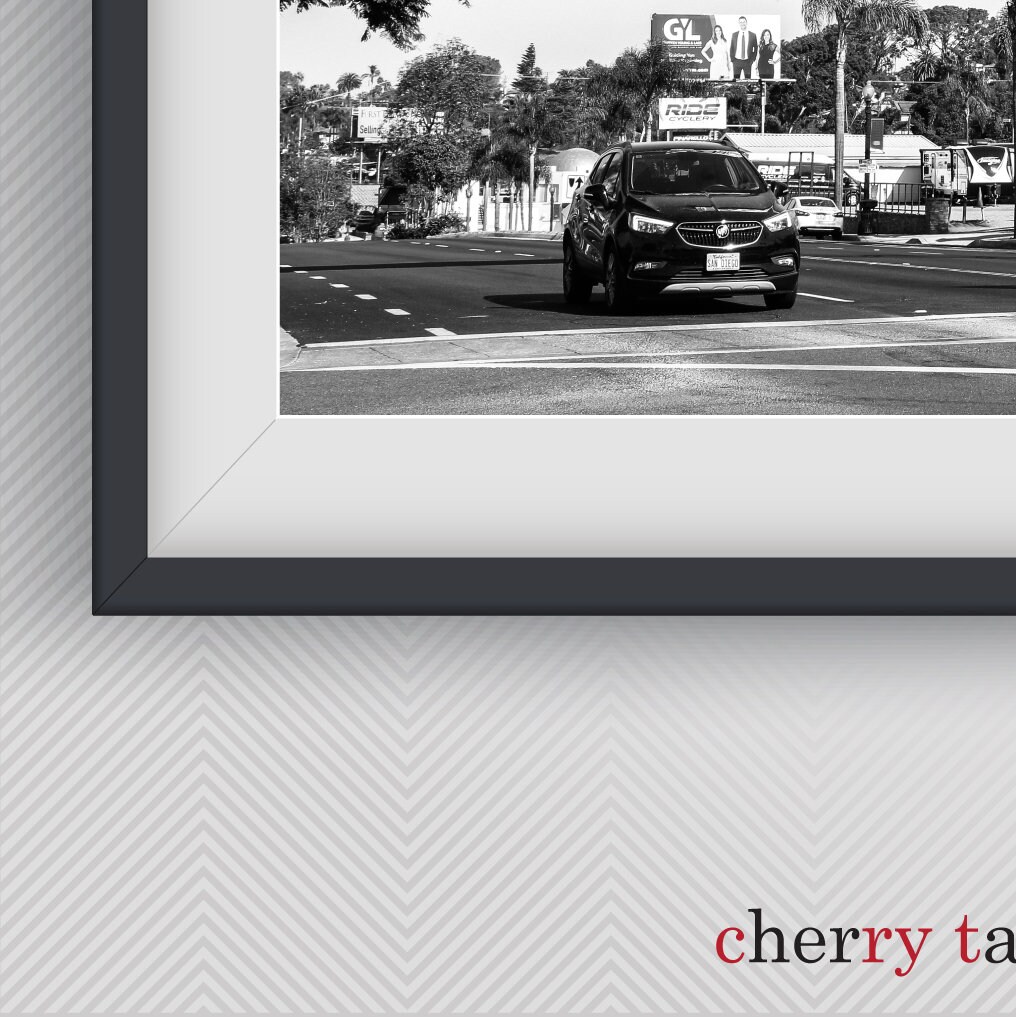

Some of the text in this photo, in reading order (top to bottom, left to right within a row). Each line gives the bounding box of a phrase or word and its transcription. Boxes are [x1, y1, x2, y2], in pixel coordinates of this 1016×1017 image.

[663, 18, 701, 41] GYL
[665, 103, 721, 116] RIDE
[359, 125, 381, 136] Selling
[757, 165, 797, 175] RIDE
[708, 259, 739, 268] SAN DIEGO
